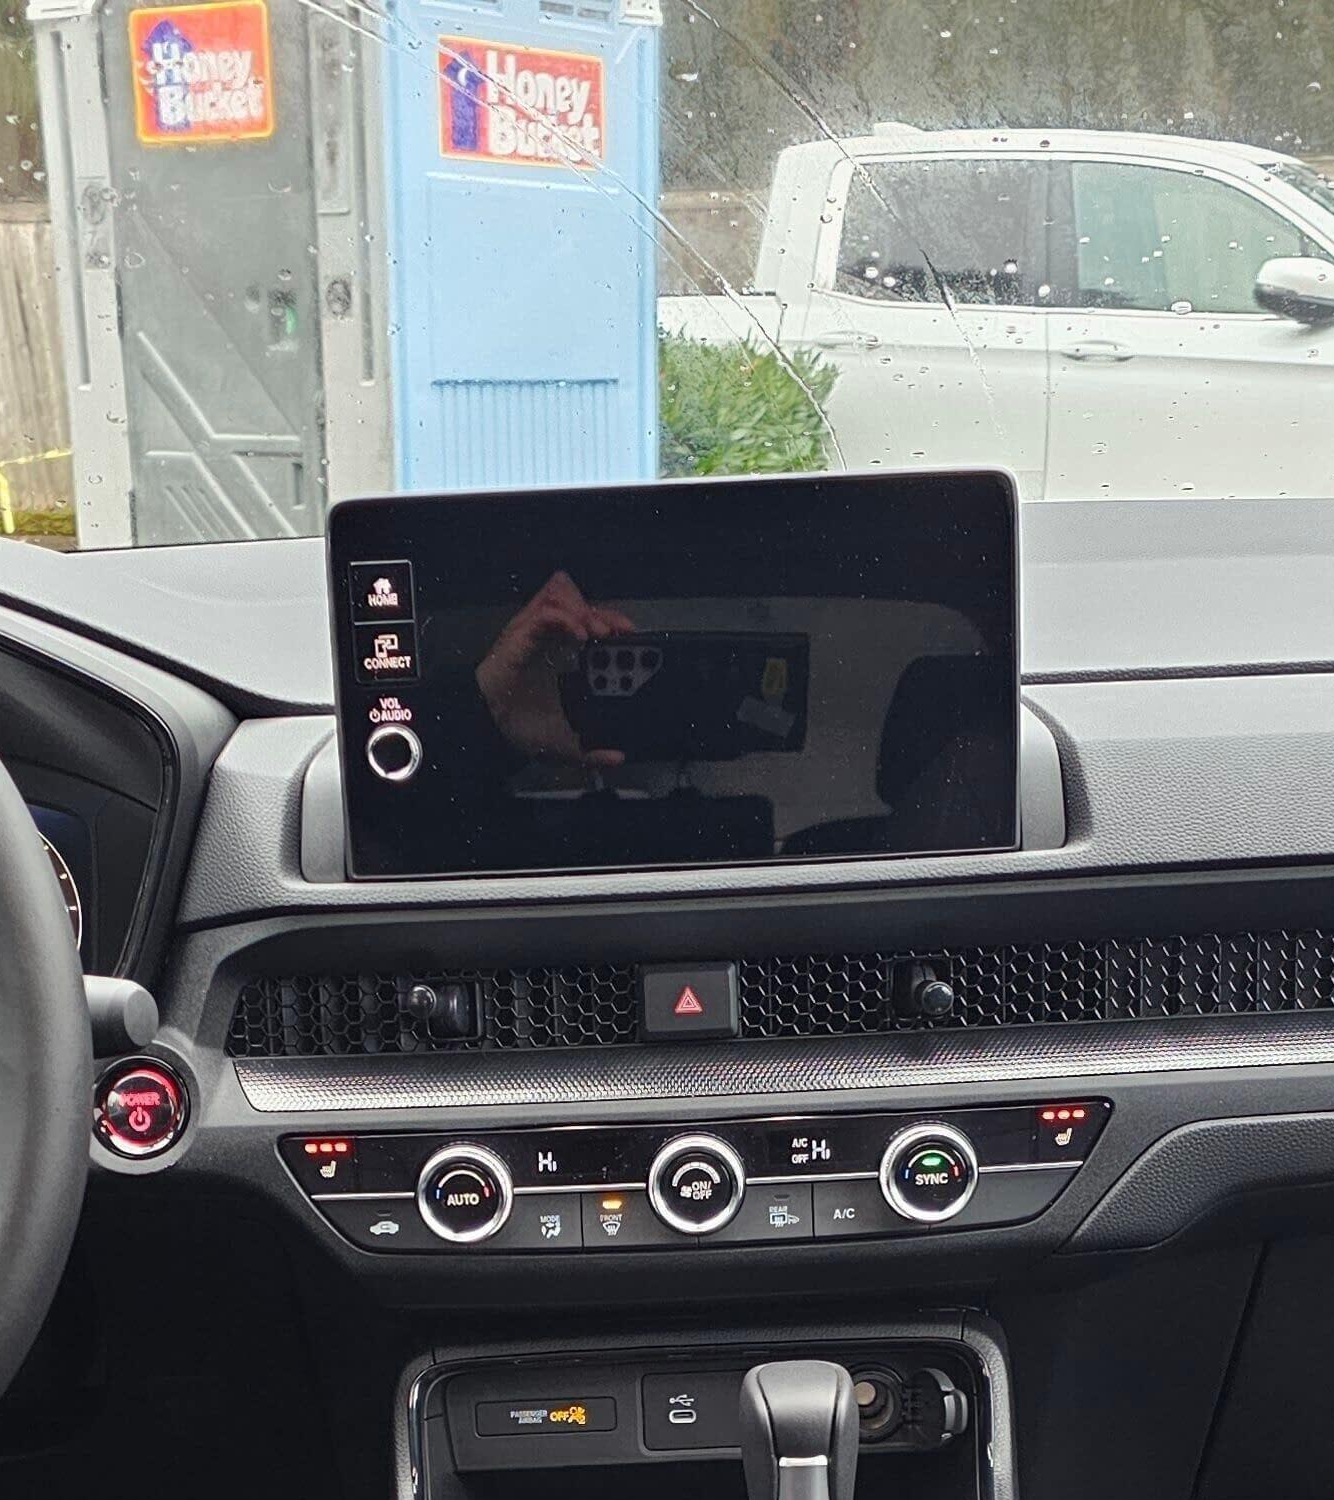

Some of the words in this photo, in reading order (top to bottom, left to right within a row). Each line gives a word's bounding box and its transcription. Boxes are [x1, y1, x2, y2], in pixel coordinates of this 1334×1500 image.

[151, 43, 252, 90] Honey
[485, 50, 591, 125] Honey
[158, 76, 264, 125] Bucket
[488, 106, 601, 162] Bucket
[368, 593, 398, 607] HOME
[364, 656, 411, 669] CONNECT
[379, 698, 401, 709] VOL
[381, 709, 412, 721] AUDIO
[791, 1137, 809, 1148] A/C
[791, 1154, 809, 1165] OFF
[915, 1173, 948, 1186] SYNC
[447, 1193, 480, 1206] AUTO
[692, 1189, 712, 1200] OFF
[540, 1215, 561, 1223] MODE
[600, 1214, 623, 1222] FRONT
[833, 1208, 855, 1219] A/C
[549, 1411, 569, 1422] OFF
